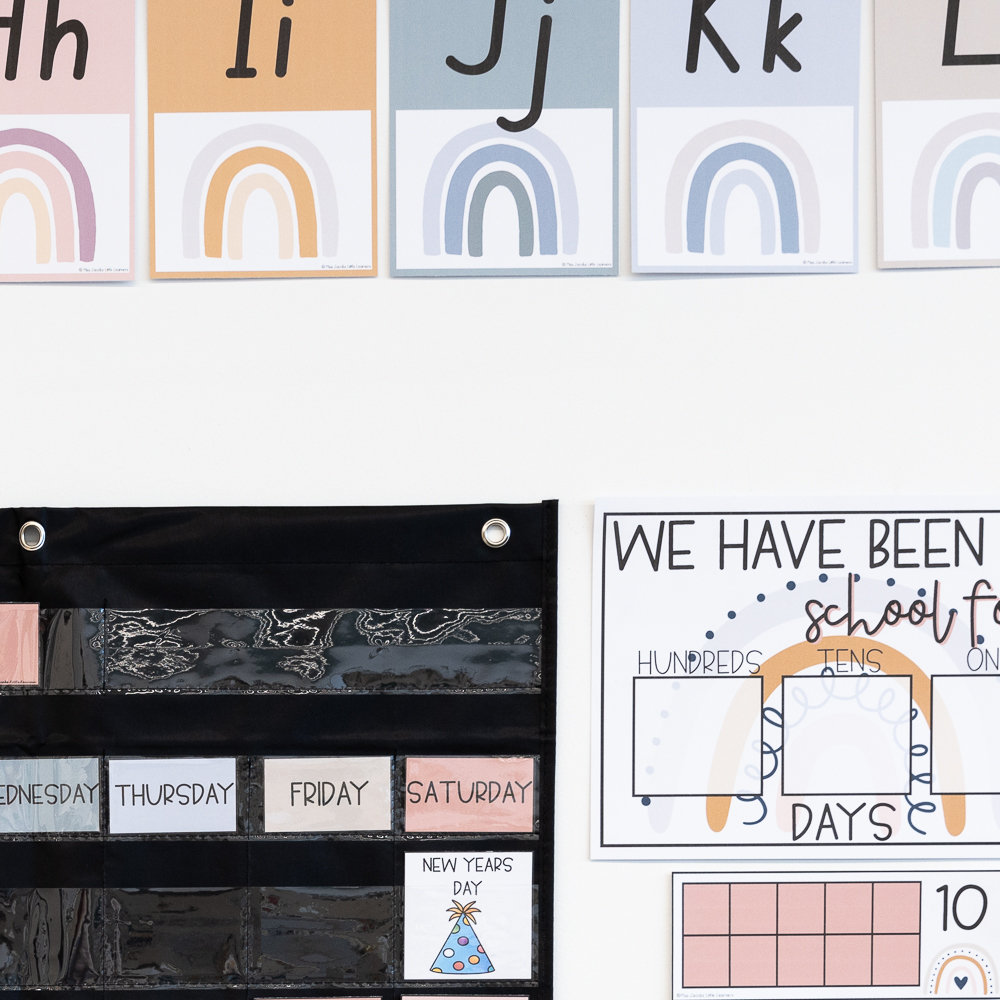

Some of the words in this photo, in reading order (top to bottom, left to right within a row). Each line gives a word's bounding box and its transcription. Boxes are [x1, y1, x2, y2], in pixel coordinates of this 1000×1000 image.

[613, 519, 696, 571] WE
[719, 518, 845, 570] HAVE
[870, 517, 984, 568] BEEN
[805, 572, 957, 643] school
[638, 650, 763, 674] HUNDREDS
[817, 648, 884, 673] TENS
[115, 783, 234, 806] THURSDAY
[291, 781, 368, 806] FRIDAY
[407, 781, 532, 803] SATURDAY
[791, 802, 897, 841] DAYS
[423, 858, 457, 872] NEW
[464, 857, 513, 872] YEARS
[454, 881, 482, 895] DAY
[936, 885, 987, 931] 10
